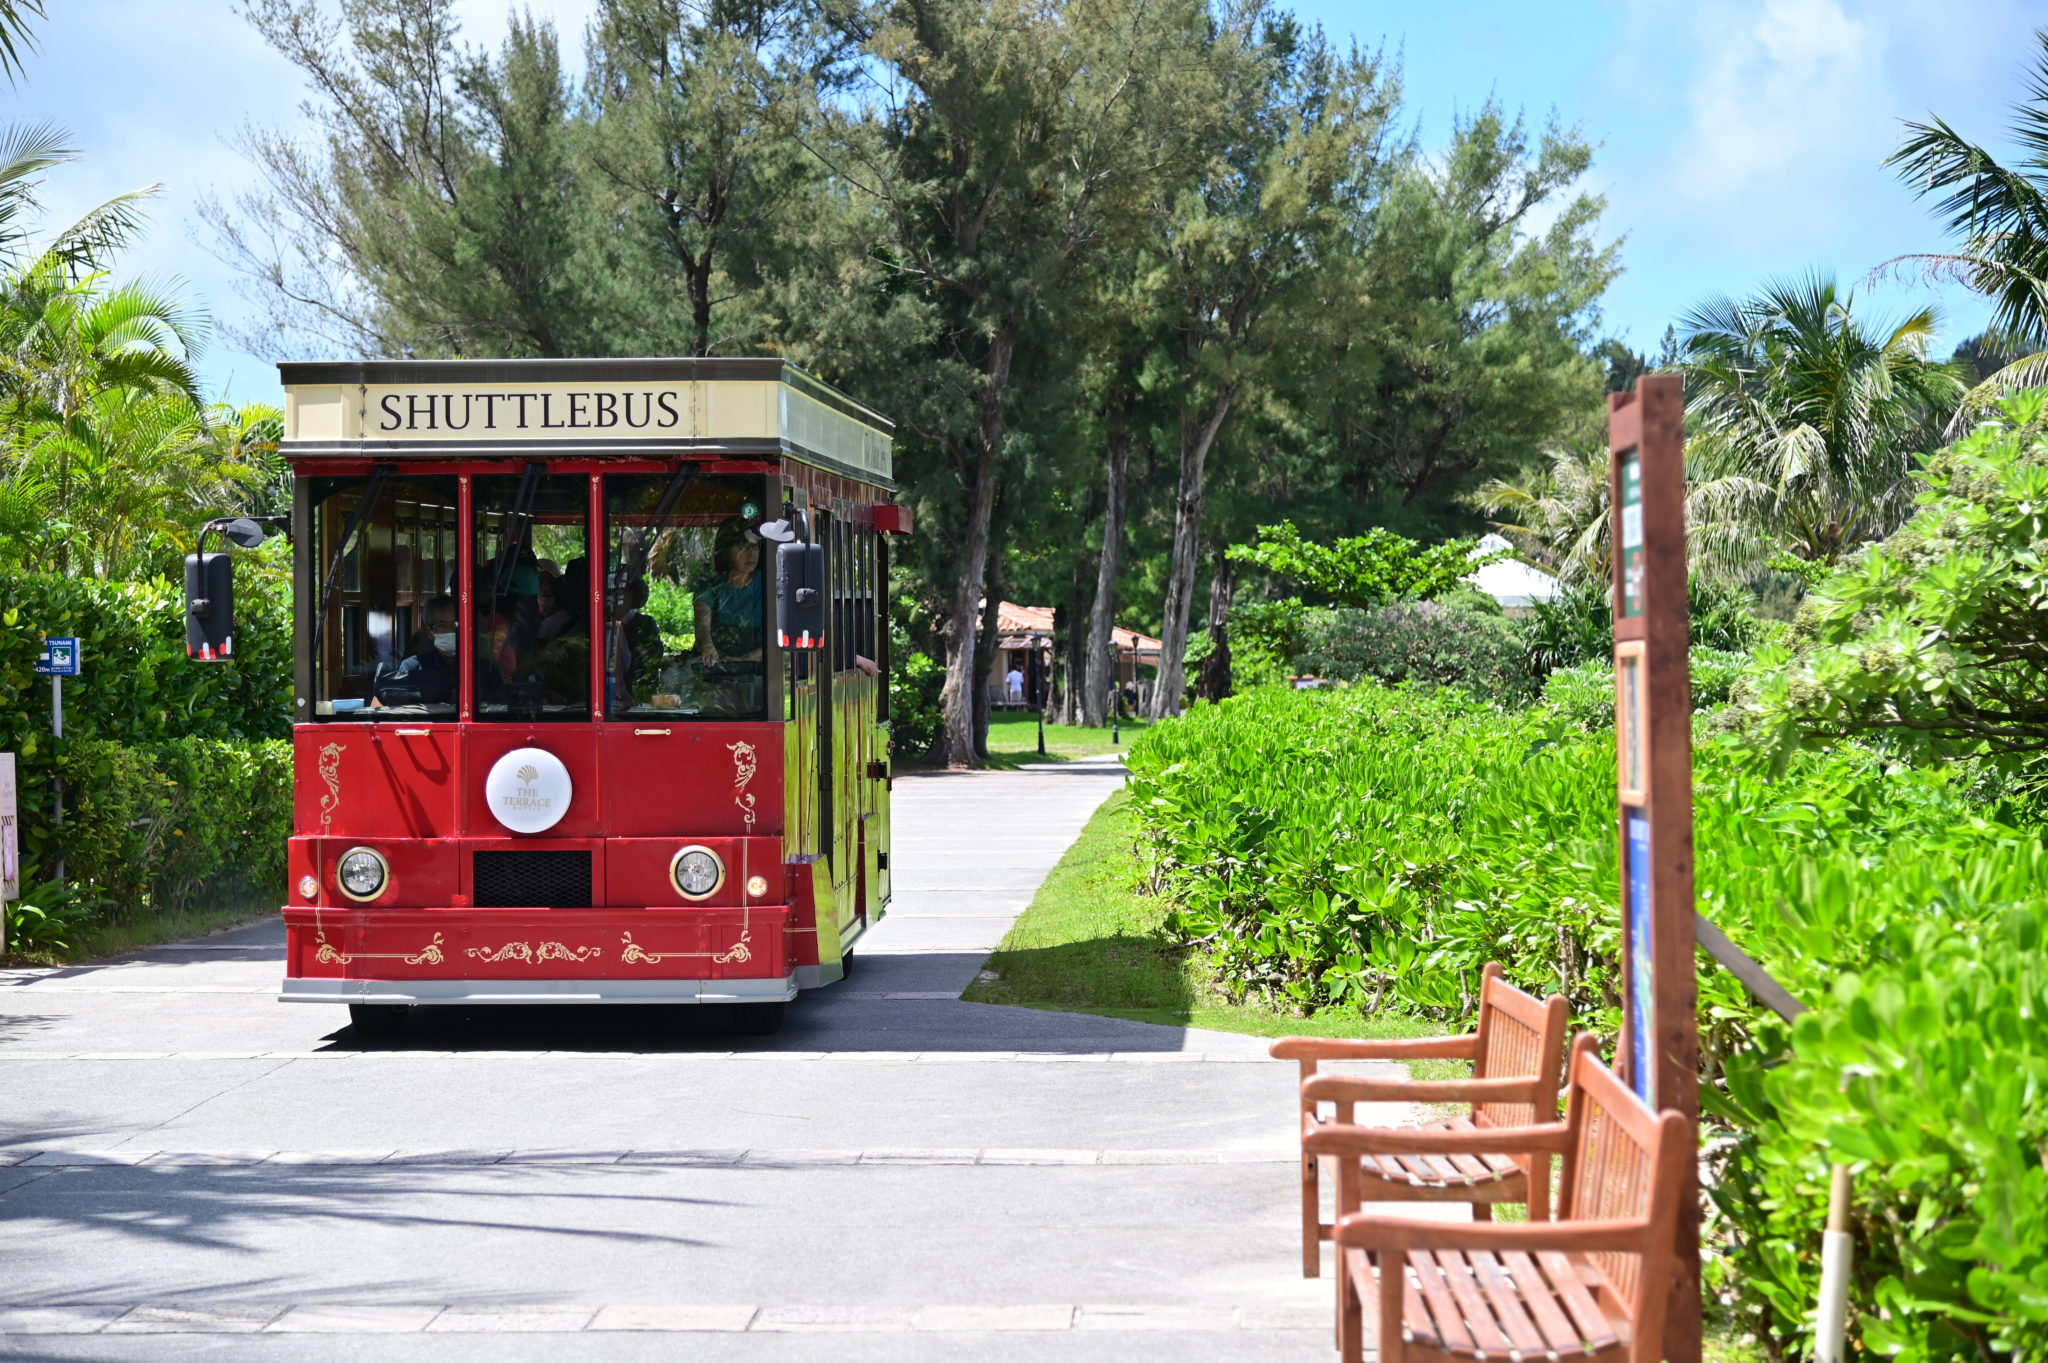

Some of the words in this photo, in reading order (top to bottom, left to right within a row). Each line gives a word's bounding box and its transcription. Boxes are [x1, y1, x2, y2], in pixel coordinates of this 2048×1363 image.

[379, 391, 679, 431] SHUTTLEBUS
[516, 787, 539, 797] THE
[502, 796, 552, 808] TERRACE
